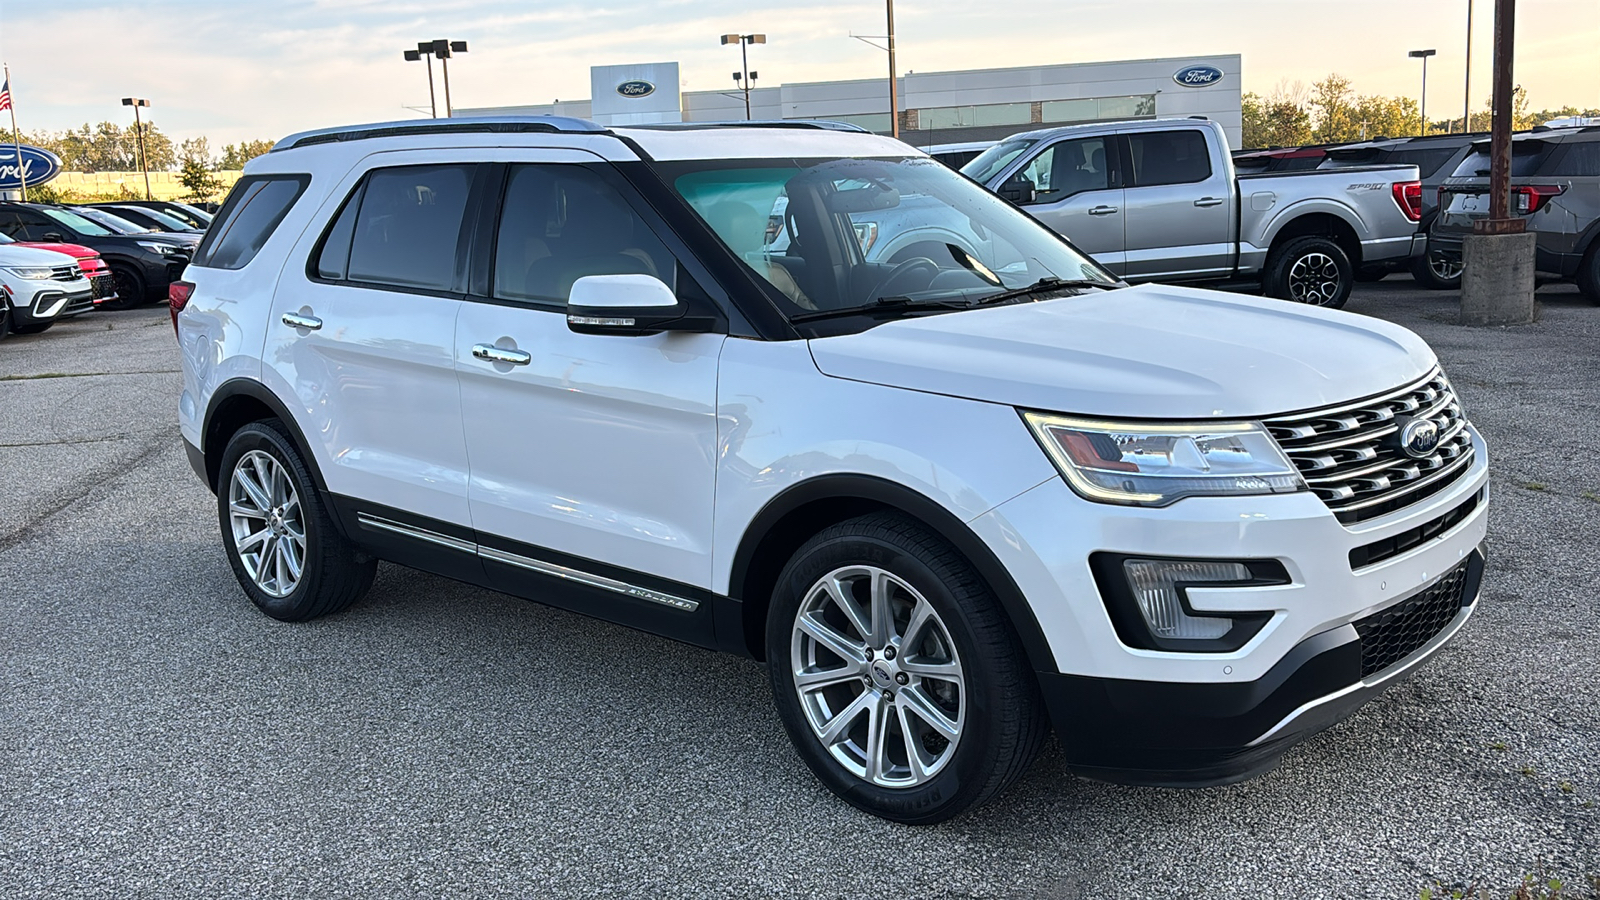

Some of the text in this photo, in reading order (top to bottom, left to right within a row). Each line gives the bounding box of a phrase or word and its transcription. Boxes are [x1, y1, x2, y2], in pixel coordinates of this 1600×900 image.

[1184, 70, 1213, 83] Ford
[623, 83, 646, 94] Ford
[0, 153, 33, 179] rd
[628, 588, 692, 609] EXPLORER
